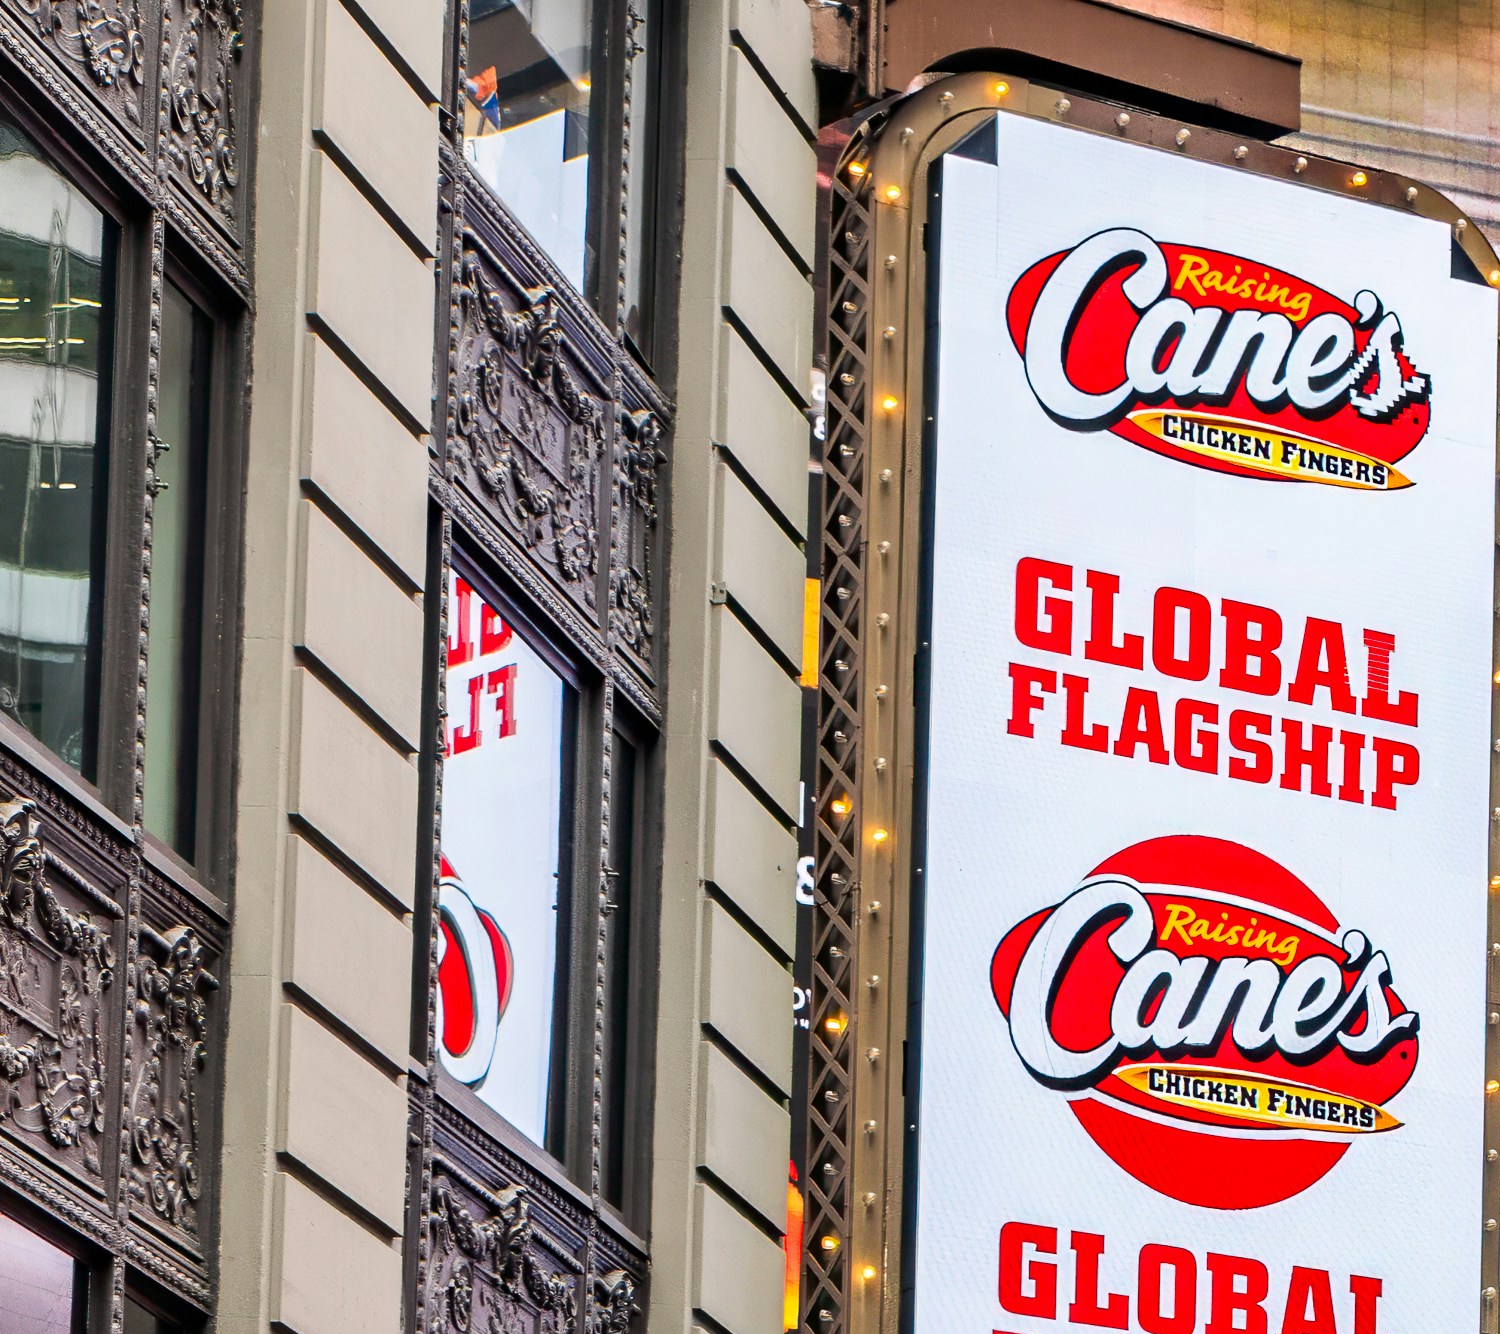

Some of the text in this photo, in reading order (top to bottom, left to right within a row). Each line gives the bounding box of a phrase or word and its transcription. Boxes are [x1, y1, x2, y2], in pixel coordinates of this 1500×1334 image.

[1025, 227, 1431, 431] Cane's
[1175, 253, 1312, 321] Raising
[1163, 414, 1386, 486] CHICKEN FINGERS
[1015, 557, 1419, 727] GLOBAL
[1007, 662, 1420, 810] FLAGSHIP
[1009, 882, 1420, 1090] Cane's
[1161, 904, 1299, 966] Raising
[1149, 1069, 1375, 1128] CHICKEN FINGERS
